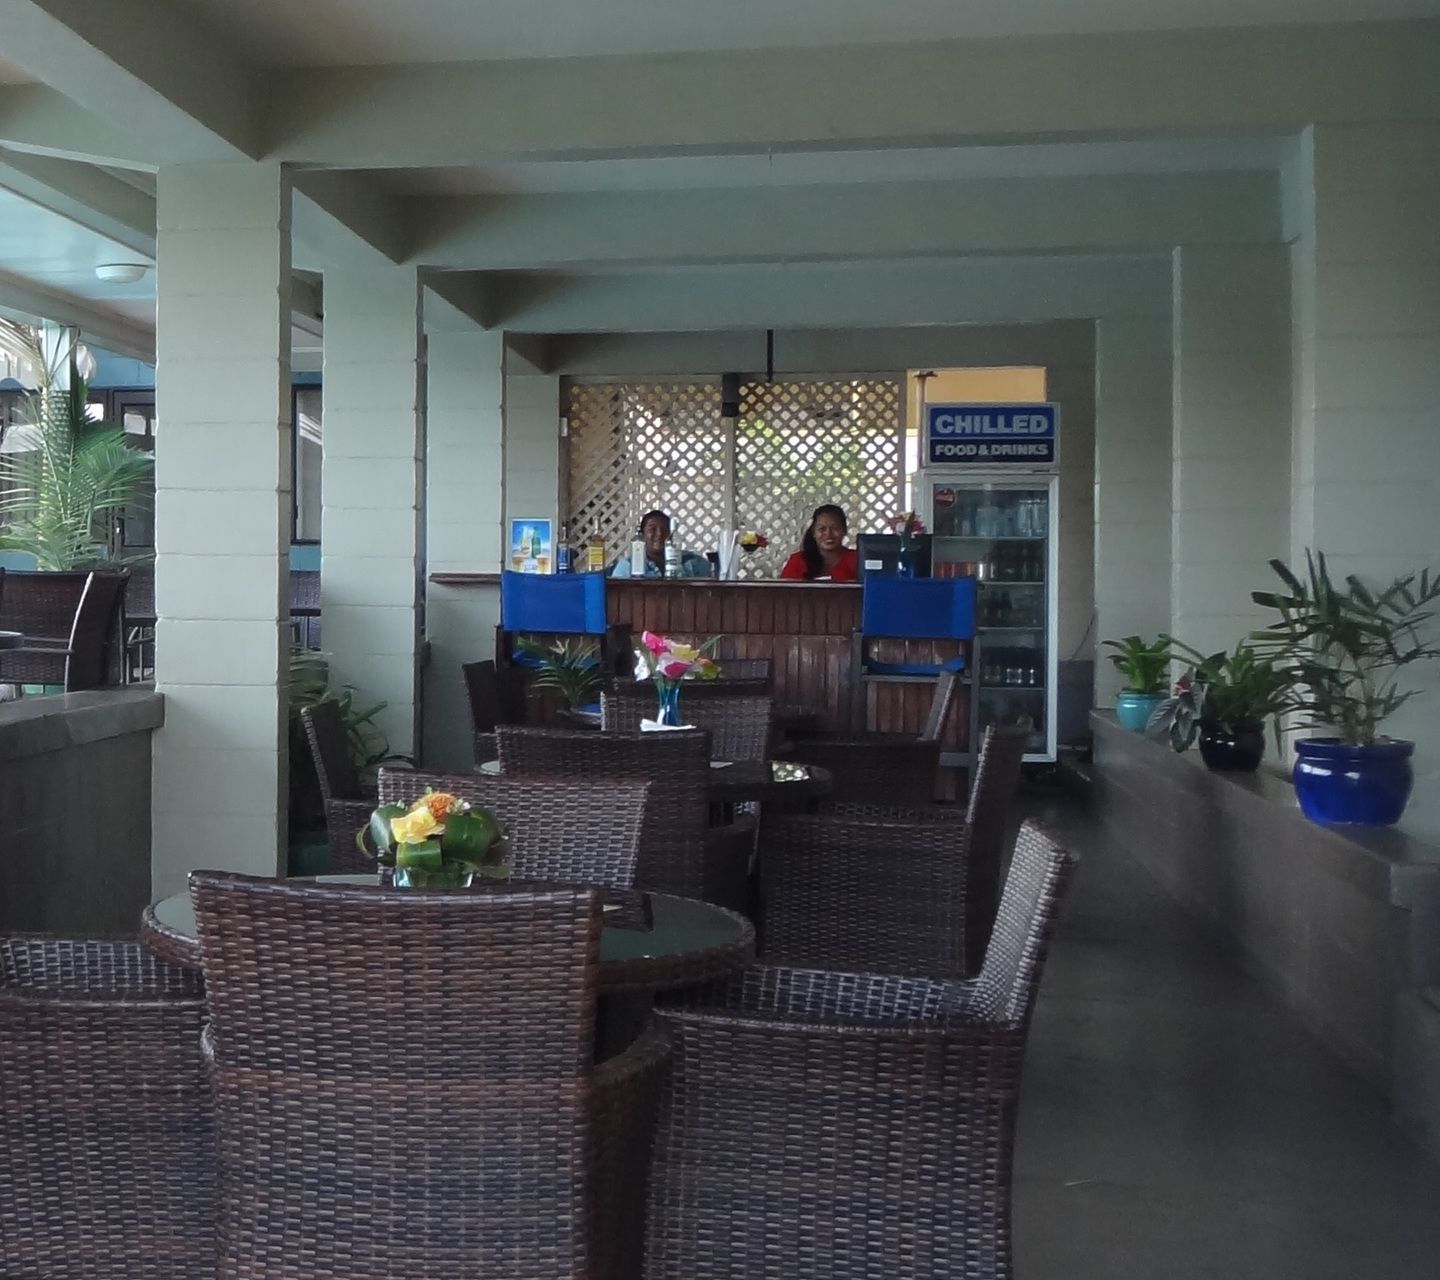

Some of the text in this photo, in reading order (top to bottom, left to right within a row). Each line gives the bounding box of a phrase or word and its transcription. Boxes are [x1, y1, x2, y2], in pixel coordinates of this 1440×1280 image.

[935, 414, 1049, 434] CHILLED
[934, 443, 1049, 456] FOOD & DRINKS
